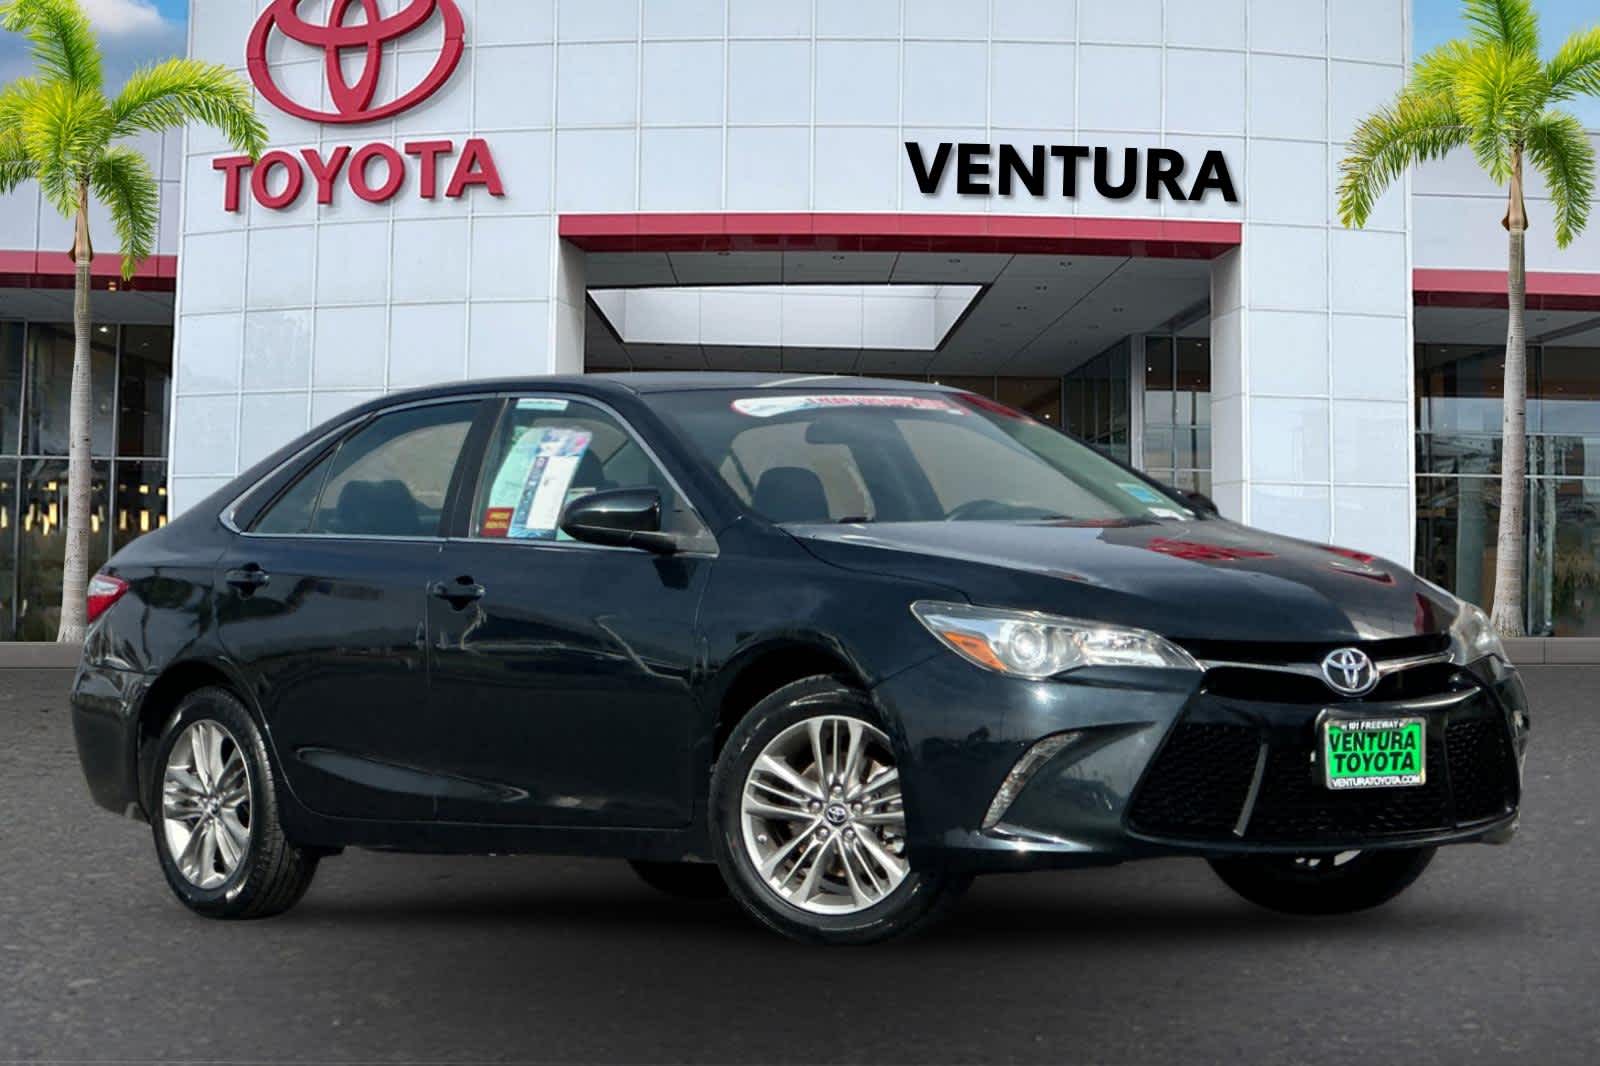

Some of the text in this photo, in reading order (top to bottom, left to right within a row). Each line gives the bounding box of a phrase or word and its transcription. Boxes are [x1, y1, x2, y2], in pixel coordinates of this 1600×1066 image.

[212, 139, 505, 212] TOYOTA
[904, 142, 1238, 202] VENTURA
[1348, 720, 1399, 730] 101 FREEWAY
[1329, 731, 1416, 752] VENTURA
[1334, 752, 1414, 773] TOYOTA
[1332, 776, 1420, 787] VENTURATOYOTA.COM
